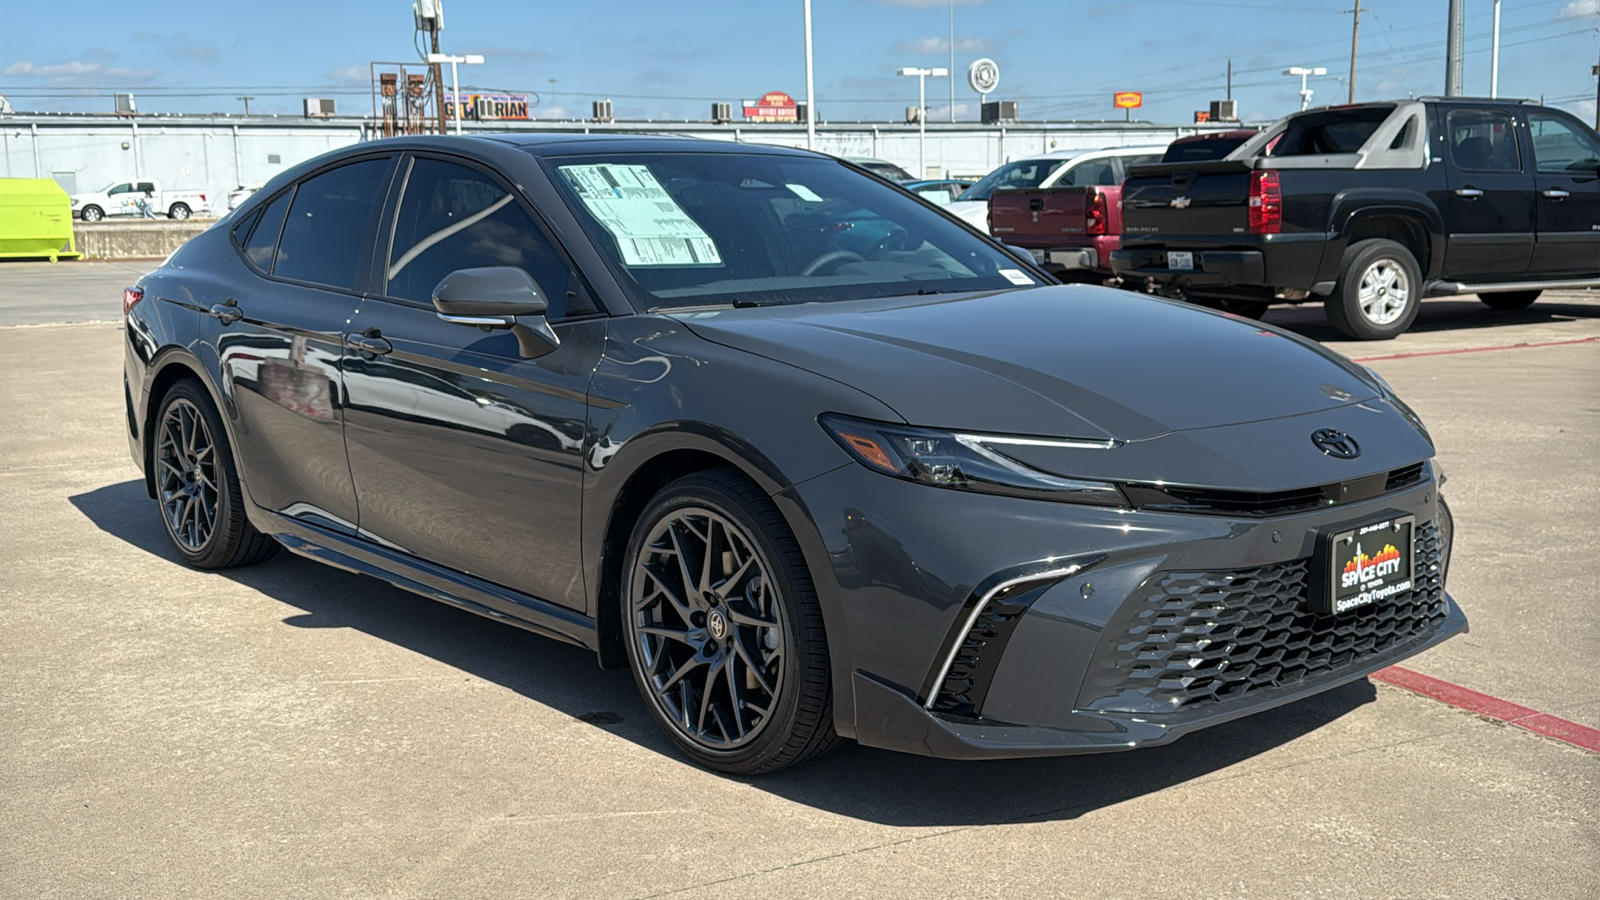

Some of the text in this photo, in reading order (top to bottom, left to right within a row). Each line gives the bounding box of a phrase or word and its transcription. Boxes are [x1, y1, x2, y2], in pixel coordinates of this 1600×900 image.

[444, 101, 468, 117] GT
[1341, 557, 1401, 588] SPACE CITY
[1336, 580, 1411, 612] SpaceCityToyota.com
